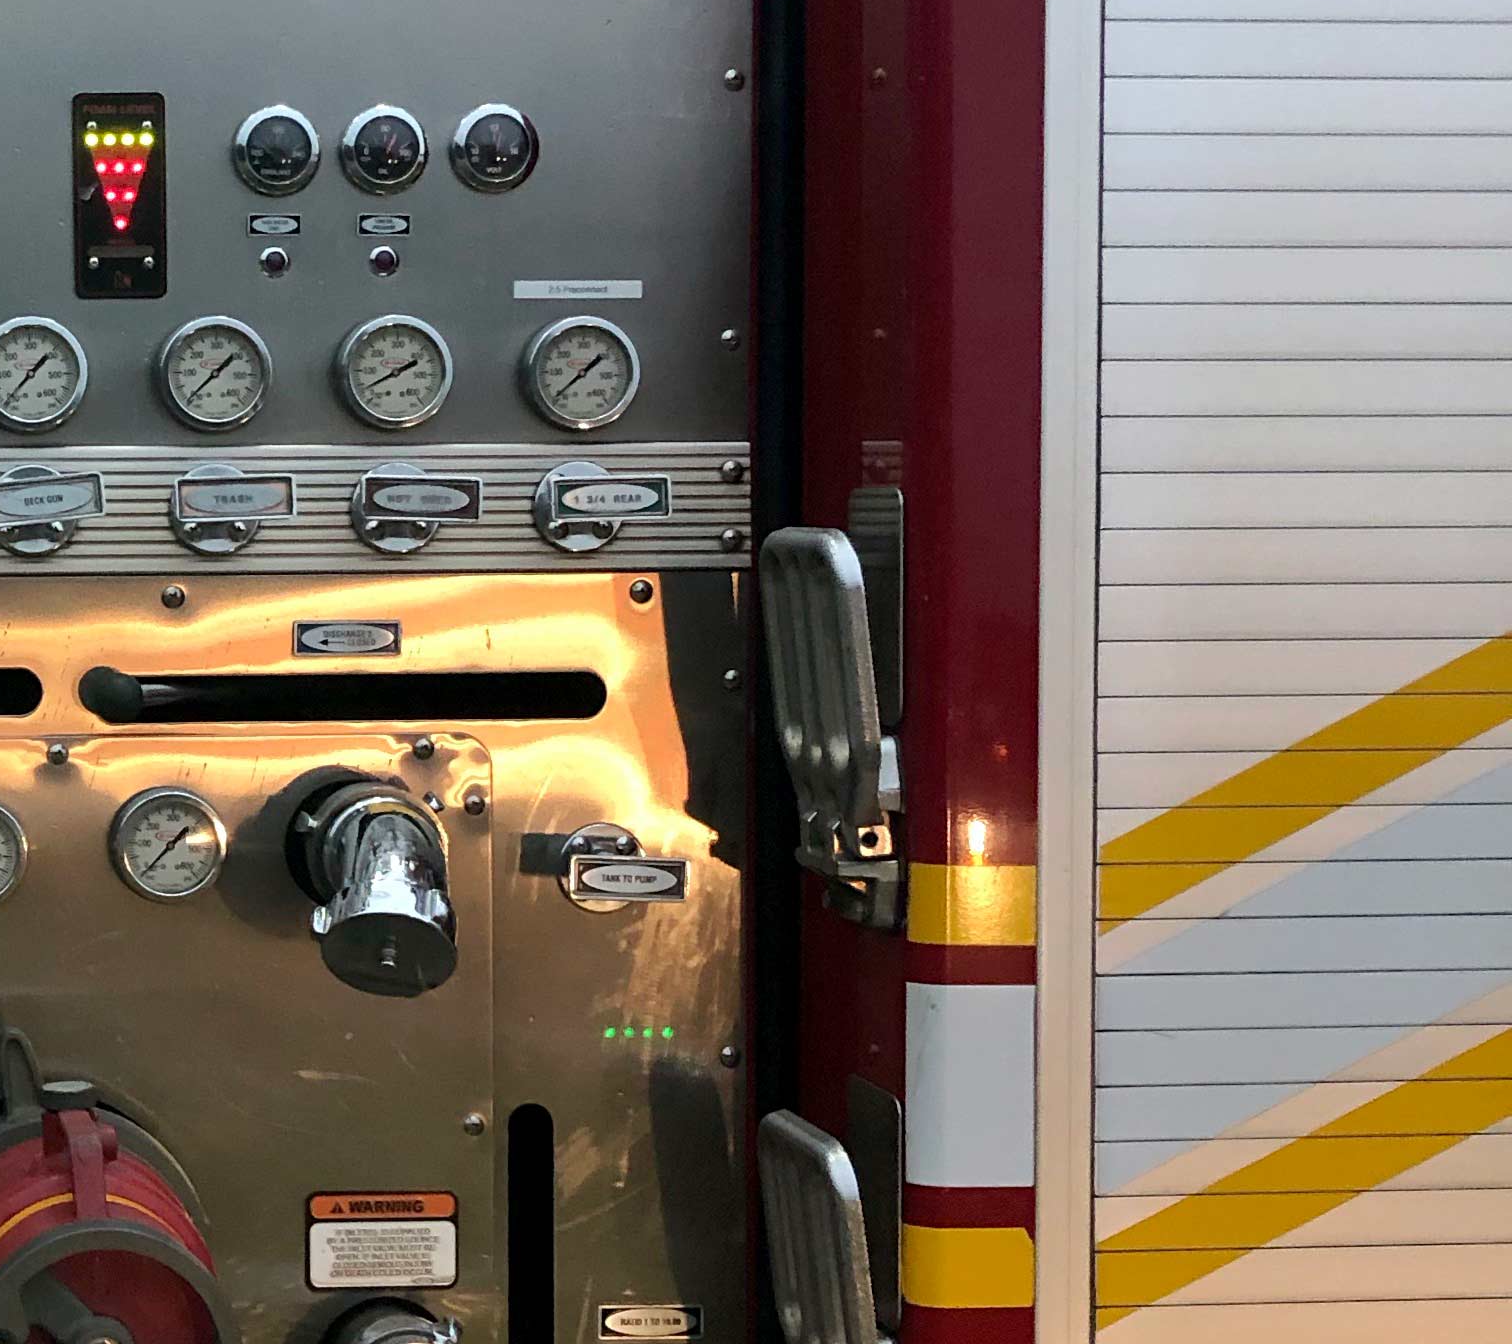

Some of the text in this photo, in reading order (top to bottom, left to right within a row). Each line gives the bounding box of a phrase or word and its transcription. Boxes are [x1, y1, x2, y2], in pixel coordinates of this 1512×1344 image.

[24, 494, 63, 506] DECK GUN
[213, 494, 254, 504] TRASH
[613, 494, 642, 504] REAR
[602, 874, 620, 882] TANK
[623, 875, 633, 883] TO
[349, 1200, 424, 1213] WARNING
